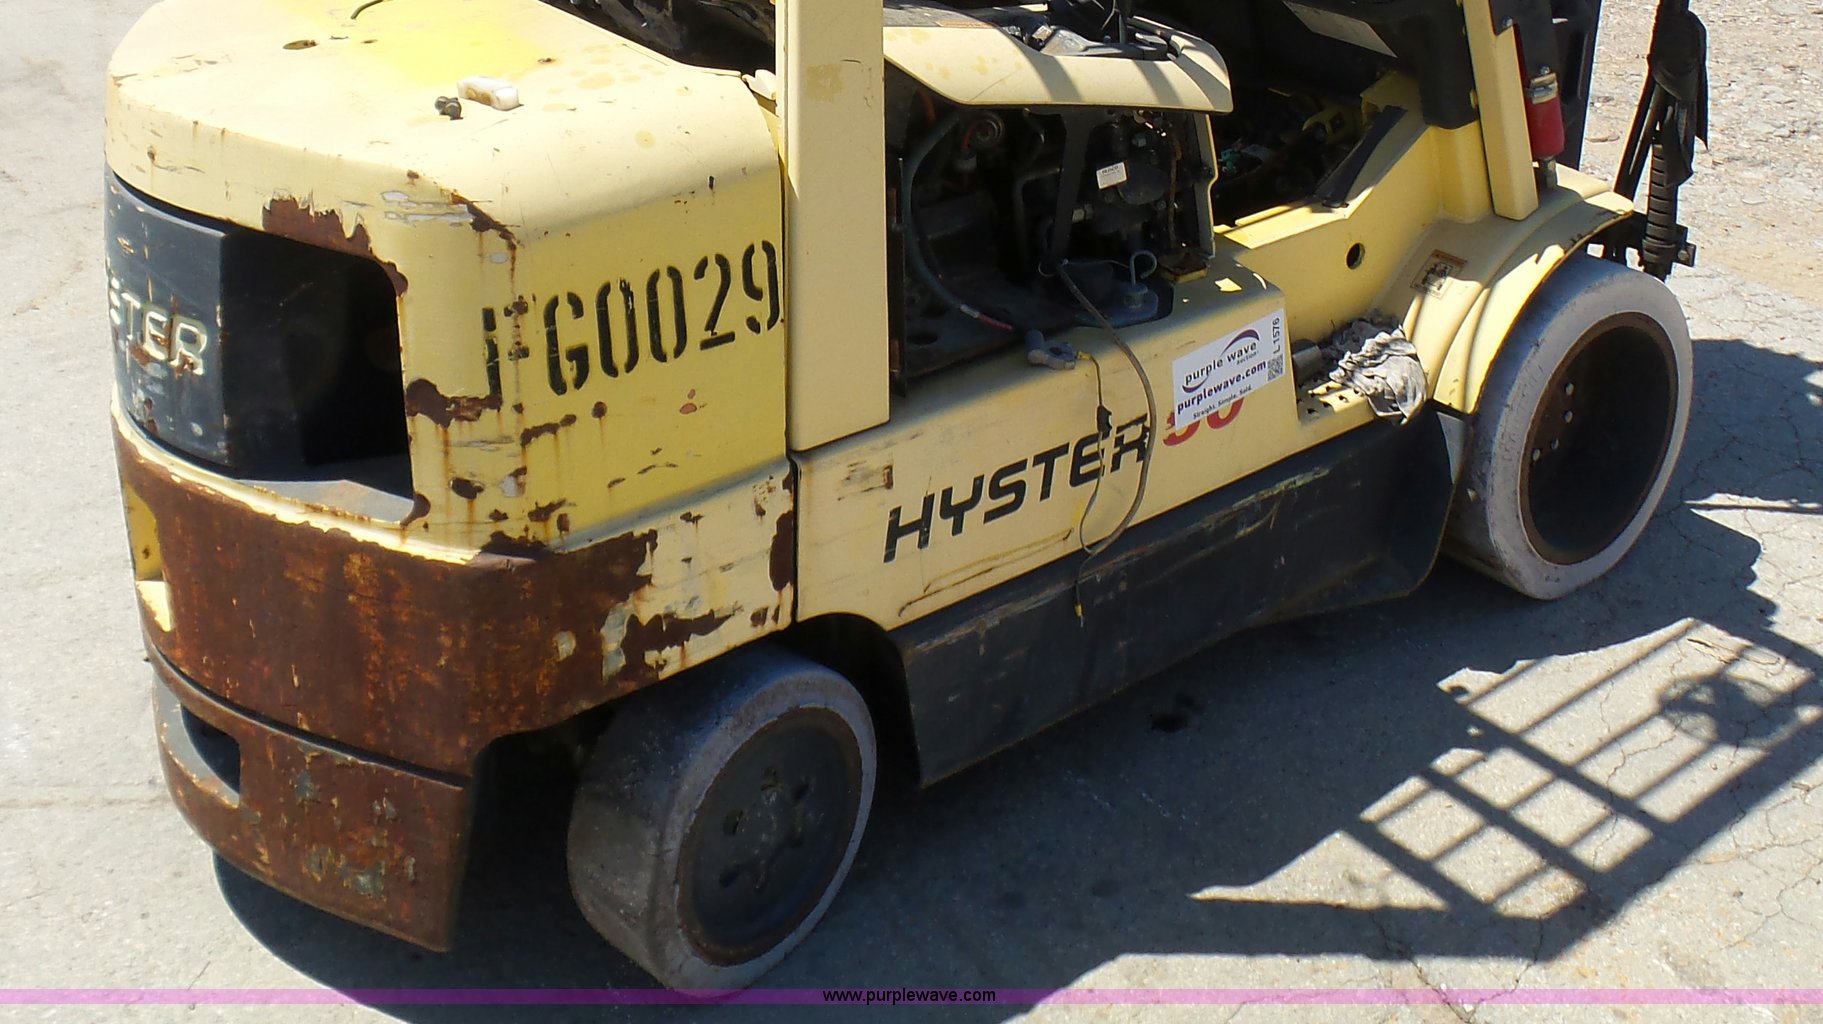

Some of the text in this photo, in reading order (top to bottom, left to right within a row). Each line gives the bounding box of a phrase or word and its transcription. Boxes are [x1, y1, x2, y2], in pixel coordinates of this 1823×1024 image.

[1272, 317, 1281, 345] 1576
[1185, 342, 1257, 385] purple wave
[1177, 361, 1267, 415] purplewave.com
[883, 413, 1150, 564] HYSTER
